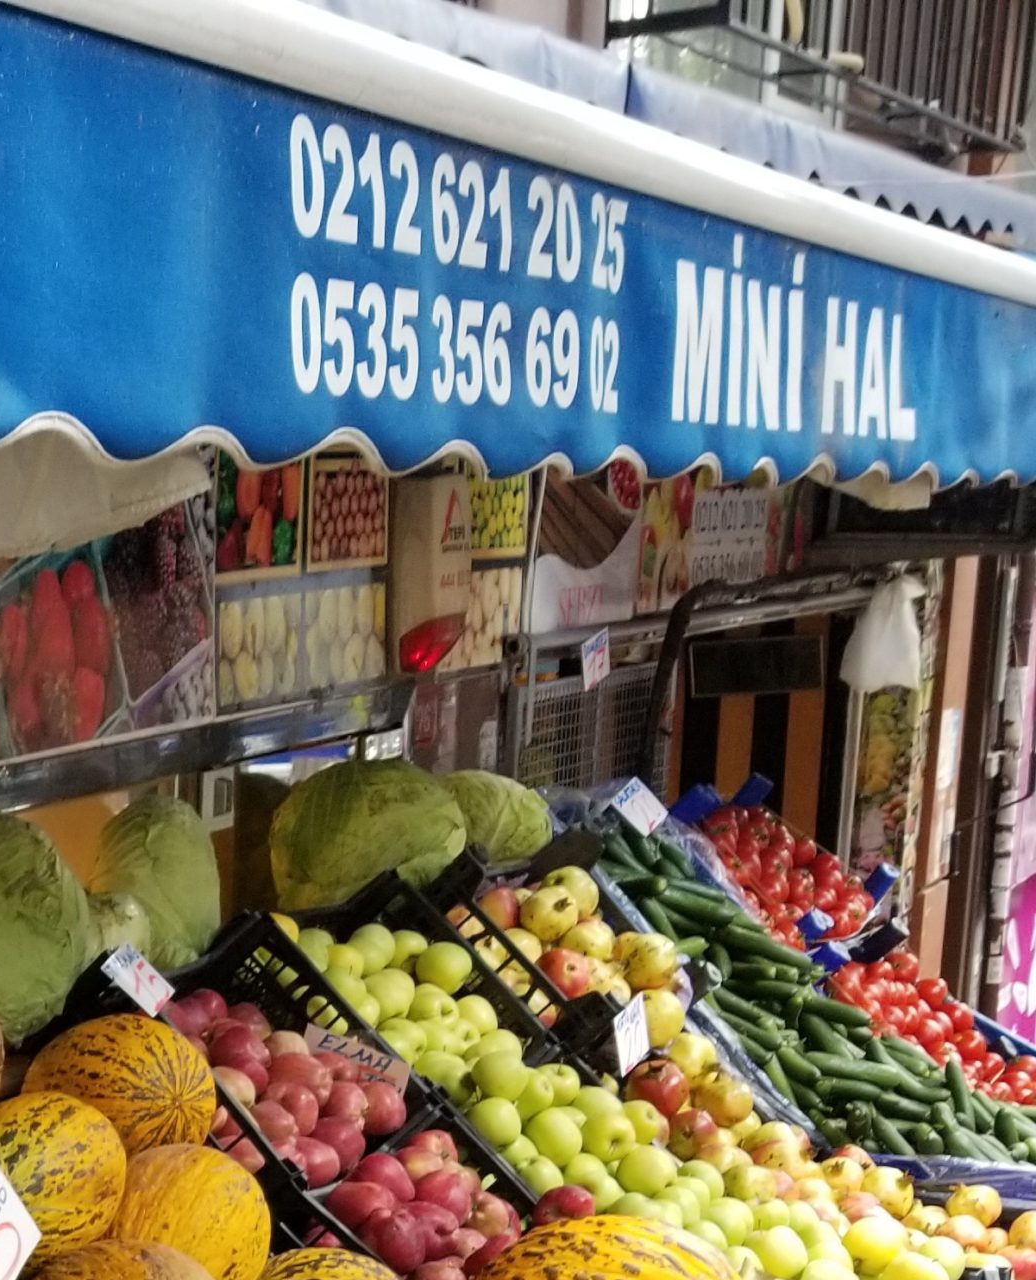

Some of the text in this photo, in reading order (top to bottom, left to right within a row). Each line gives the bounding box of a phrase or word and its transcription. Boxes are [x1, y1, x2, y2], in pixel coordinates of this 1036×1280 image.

[289, 113, 628, 295] 0212 621 20 25
[290, 271, 620, 414] 0535 356 69 02
[821, 295, 916, 442] HAL
[317, 1033, 393, 1073] ELMA
